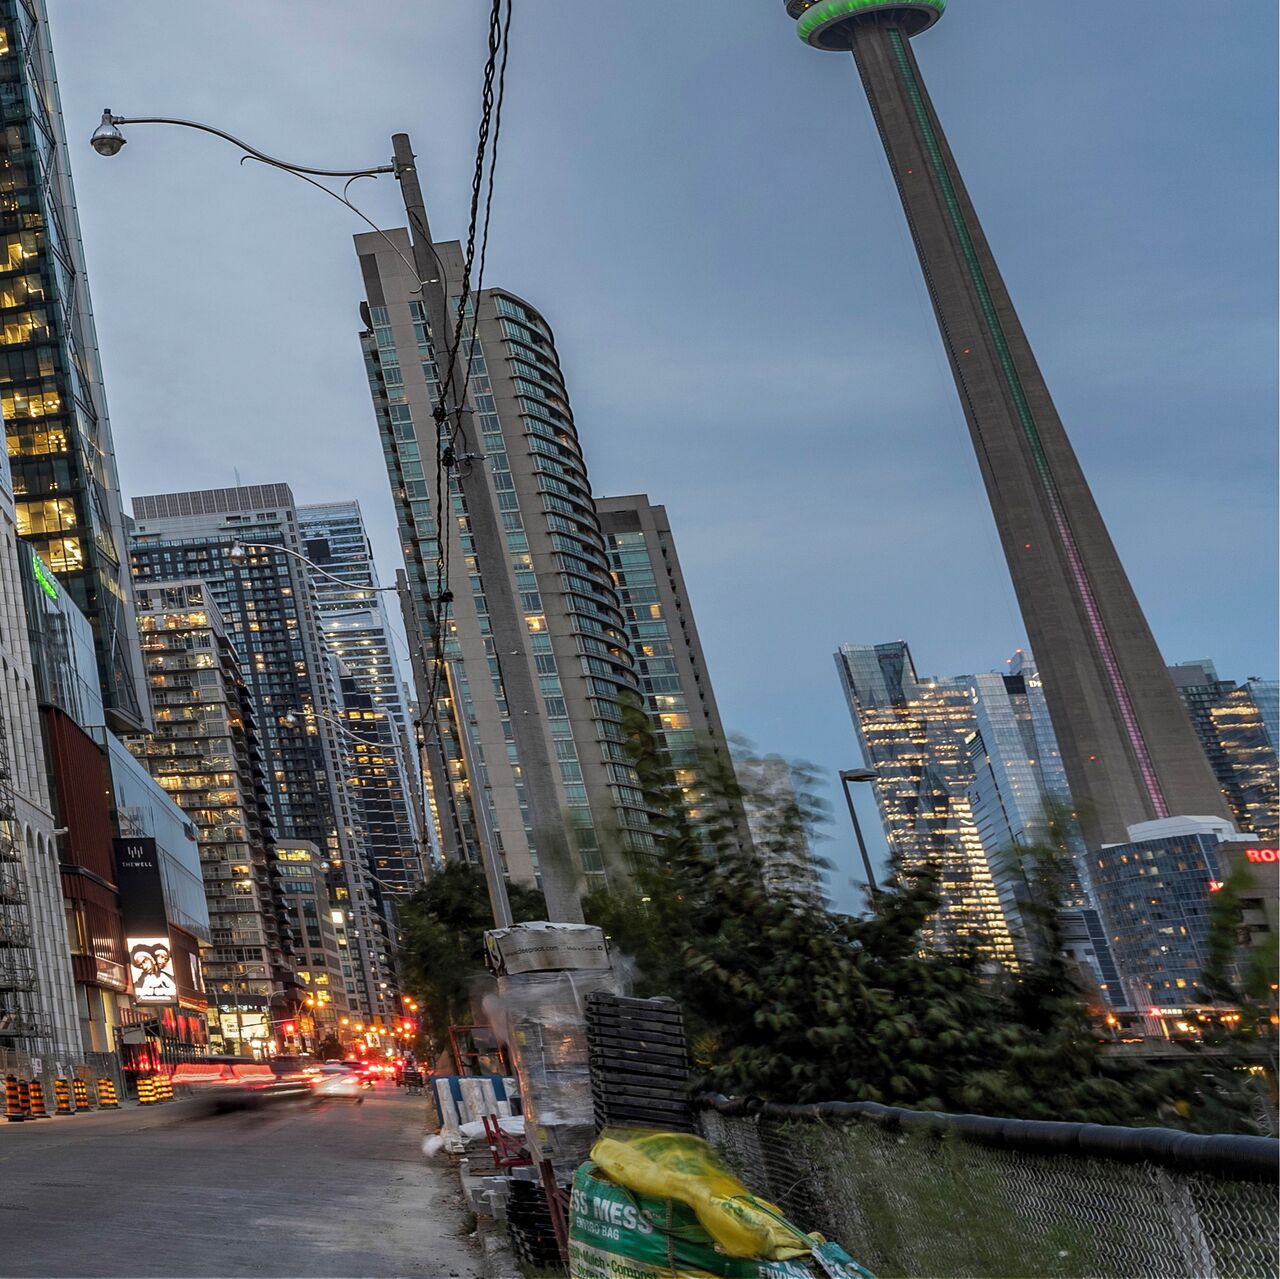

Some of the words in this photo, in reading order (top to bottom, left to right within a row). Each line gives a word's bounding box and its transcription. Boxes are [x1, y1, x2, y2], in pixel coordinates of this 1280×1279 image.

[1245, 849, 1279, 863] RO
[593, 1196, 654, 1235] MESS
[576, 1216, 600, 1235] ENVIRO
[601, 1223, 620, 1241] BAG
